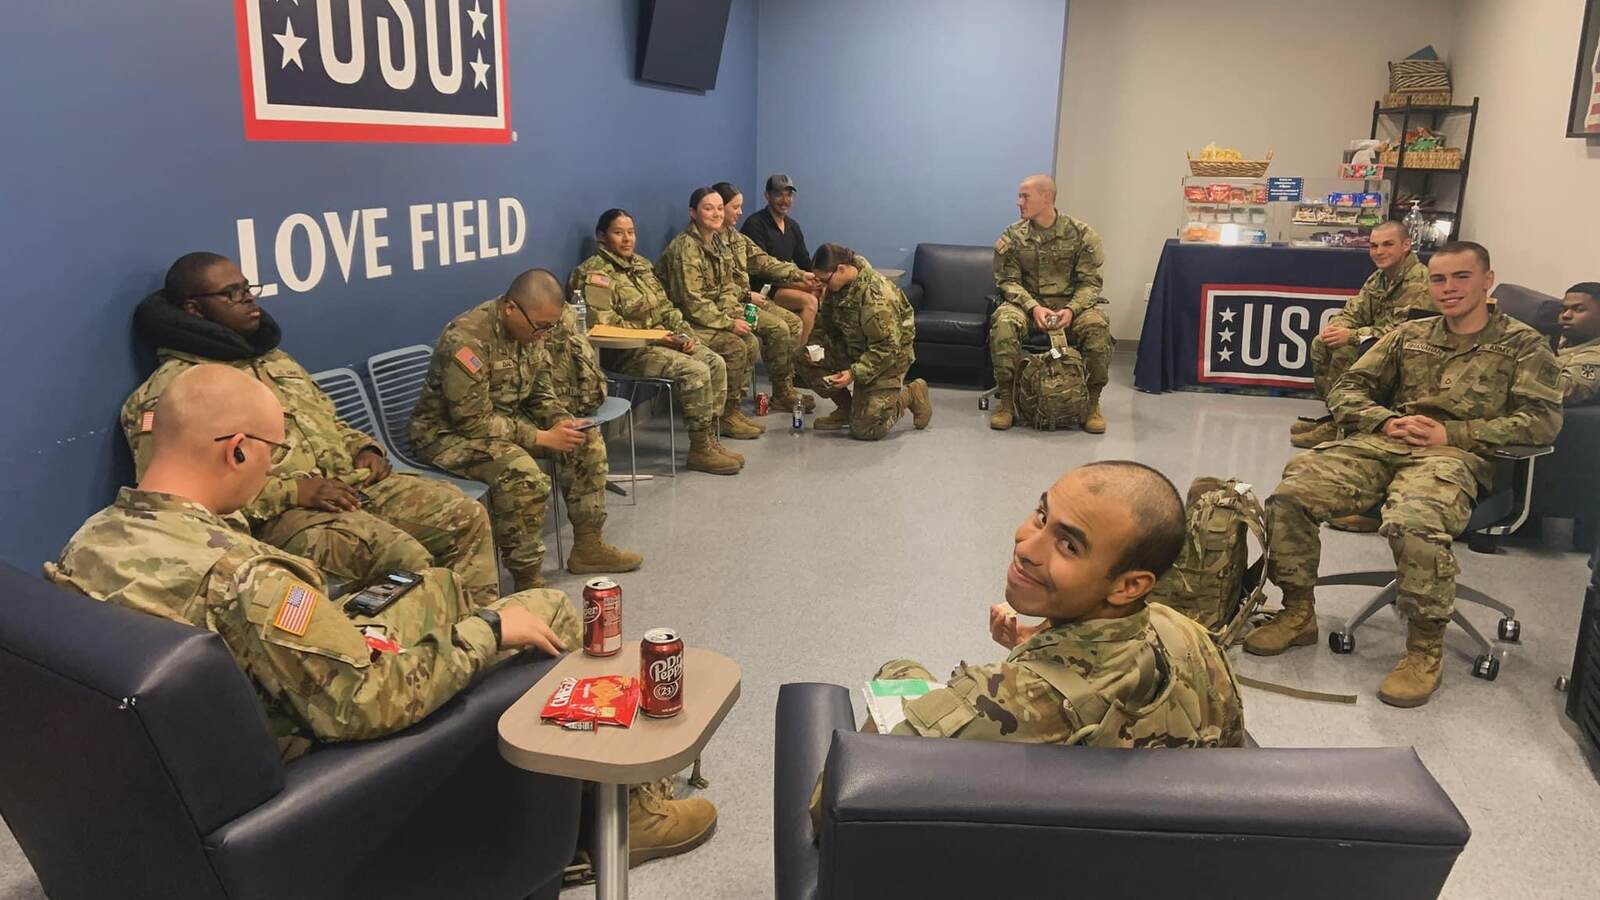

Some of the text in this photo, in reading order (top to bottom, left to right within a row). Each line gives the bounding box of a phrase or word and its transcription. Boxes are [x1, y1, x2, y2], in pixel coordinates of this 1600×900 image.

[236, 197, 526, 298] LOVE FIELD
[1241, 303, 1345, 370] US
[649, 659, 683, 683] Pepp
